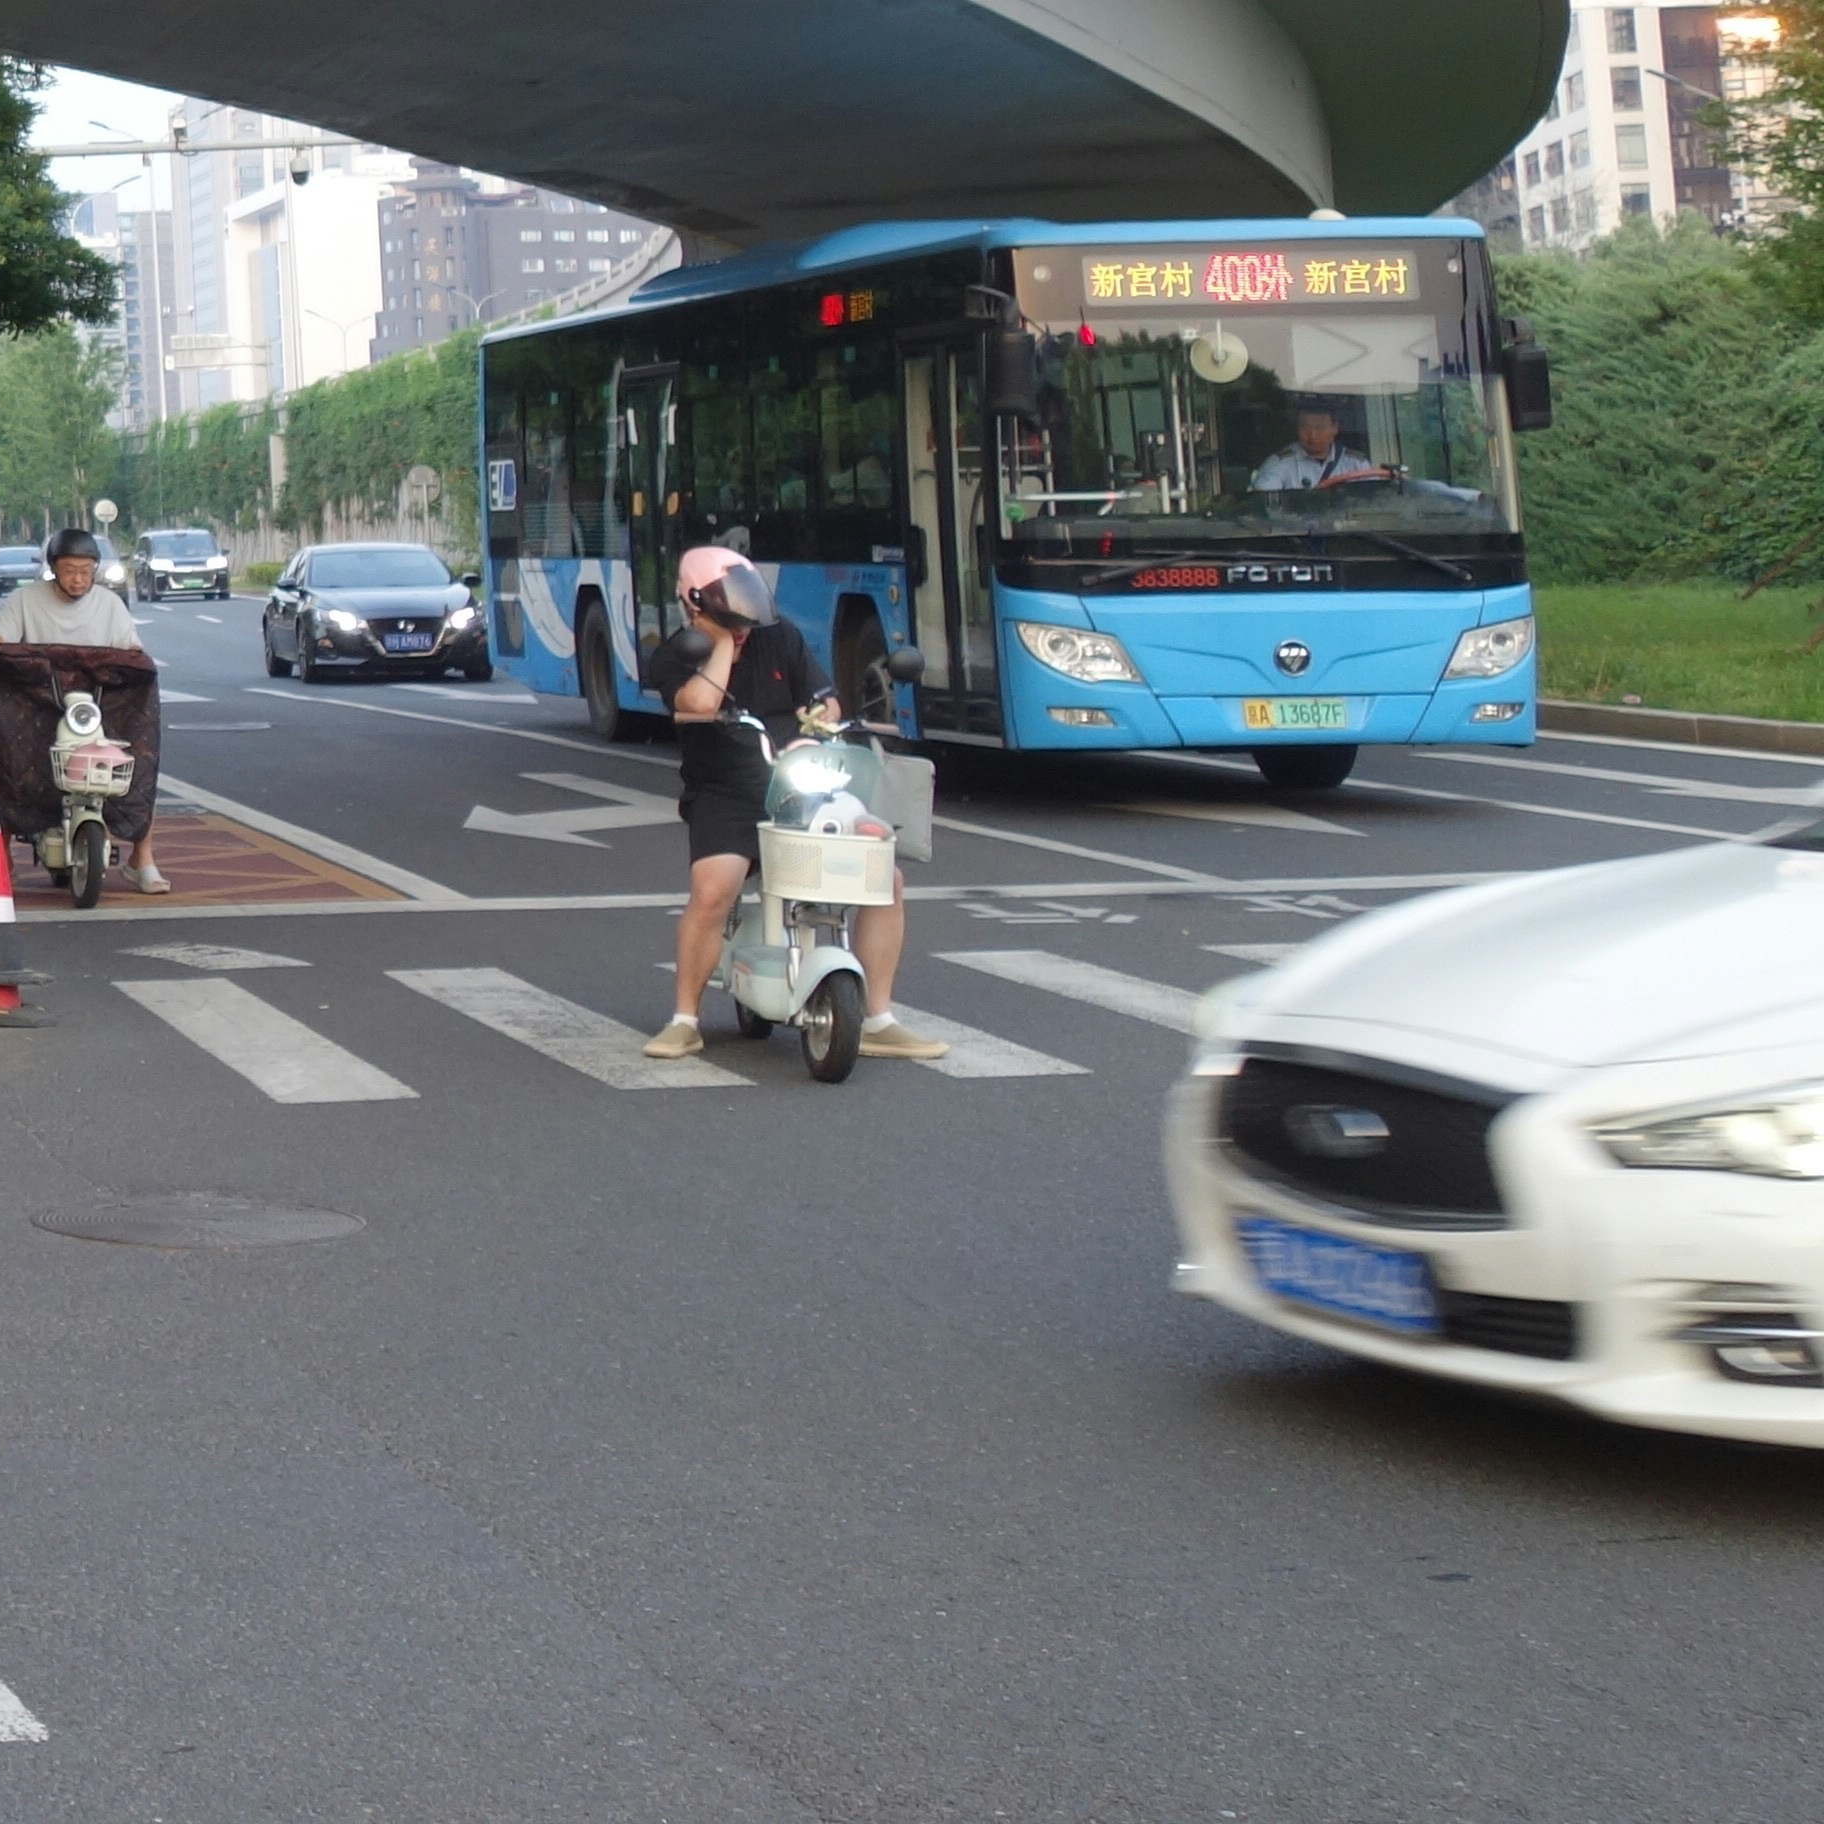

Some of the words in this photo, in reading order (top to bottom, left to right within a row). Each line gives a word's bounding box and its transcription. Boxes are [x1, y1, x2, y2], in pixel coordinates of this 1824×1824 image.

[1090, 262, 1193, 298] 新宫村
[1304, 259, 1408, 294] 新宫村
